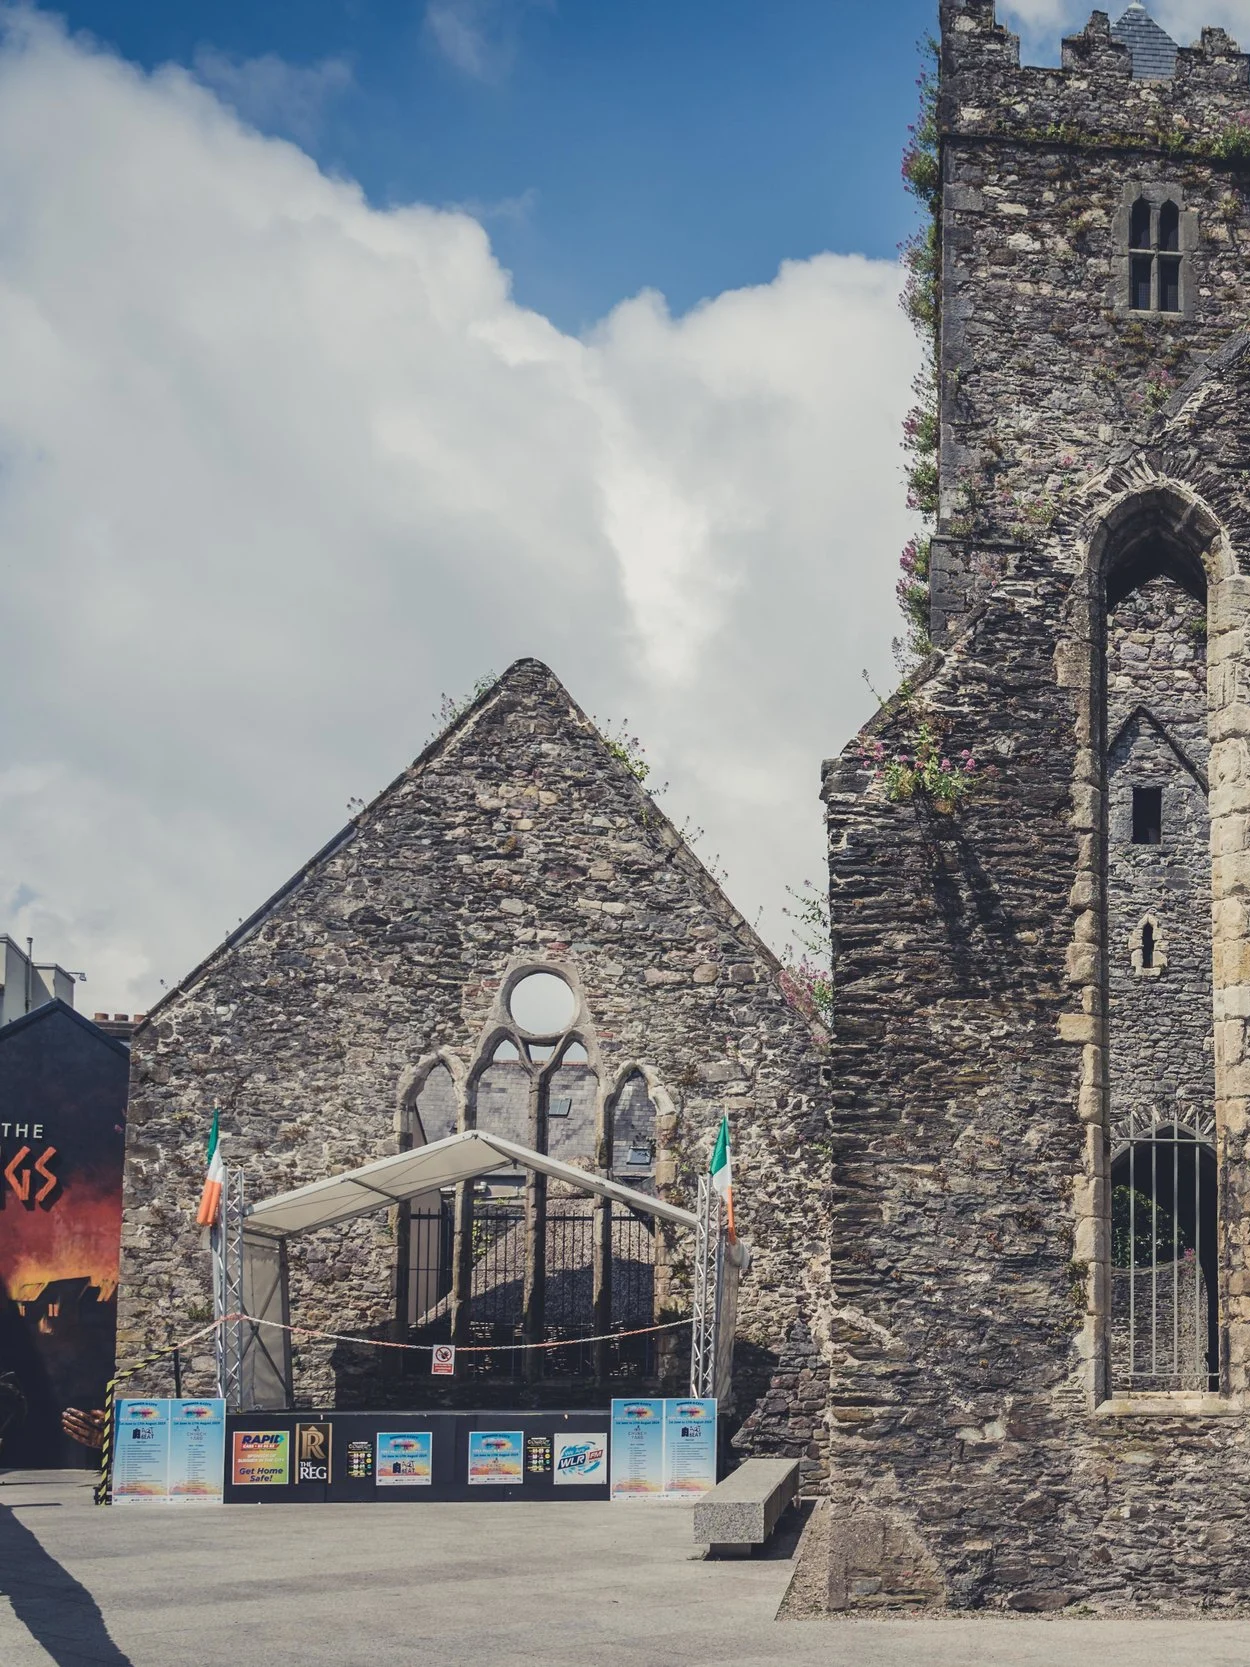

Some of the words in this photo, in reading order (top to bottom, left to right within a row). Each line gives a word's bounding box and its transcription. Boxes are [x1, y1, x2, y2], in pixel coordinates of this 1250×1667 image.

[1, 1122, 43, 1139] THE
[242, 1434, 285, 1444] RAPID
[560, 1454, 584, 1468] WLR
[589, 1450, 602, 1458] FM
[249, 1474, 273, 1482] Safe!
[300, 1466, 327, 1480] REG
